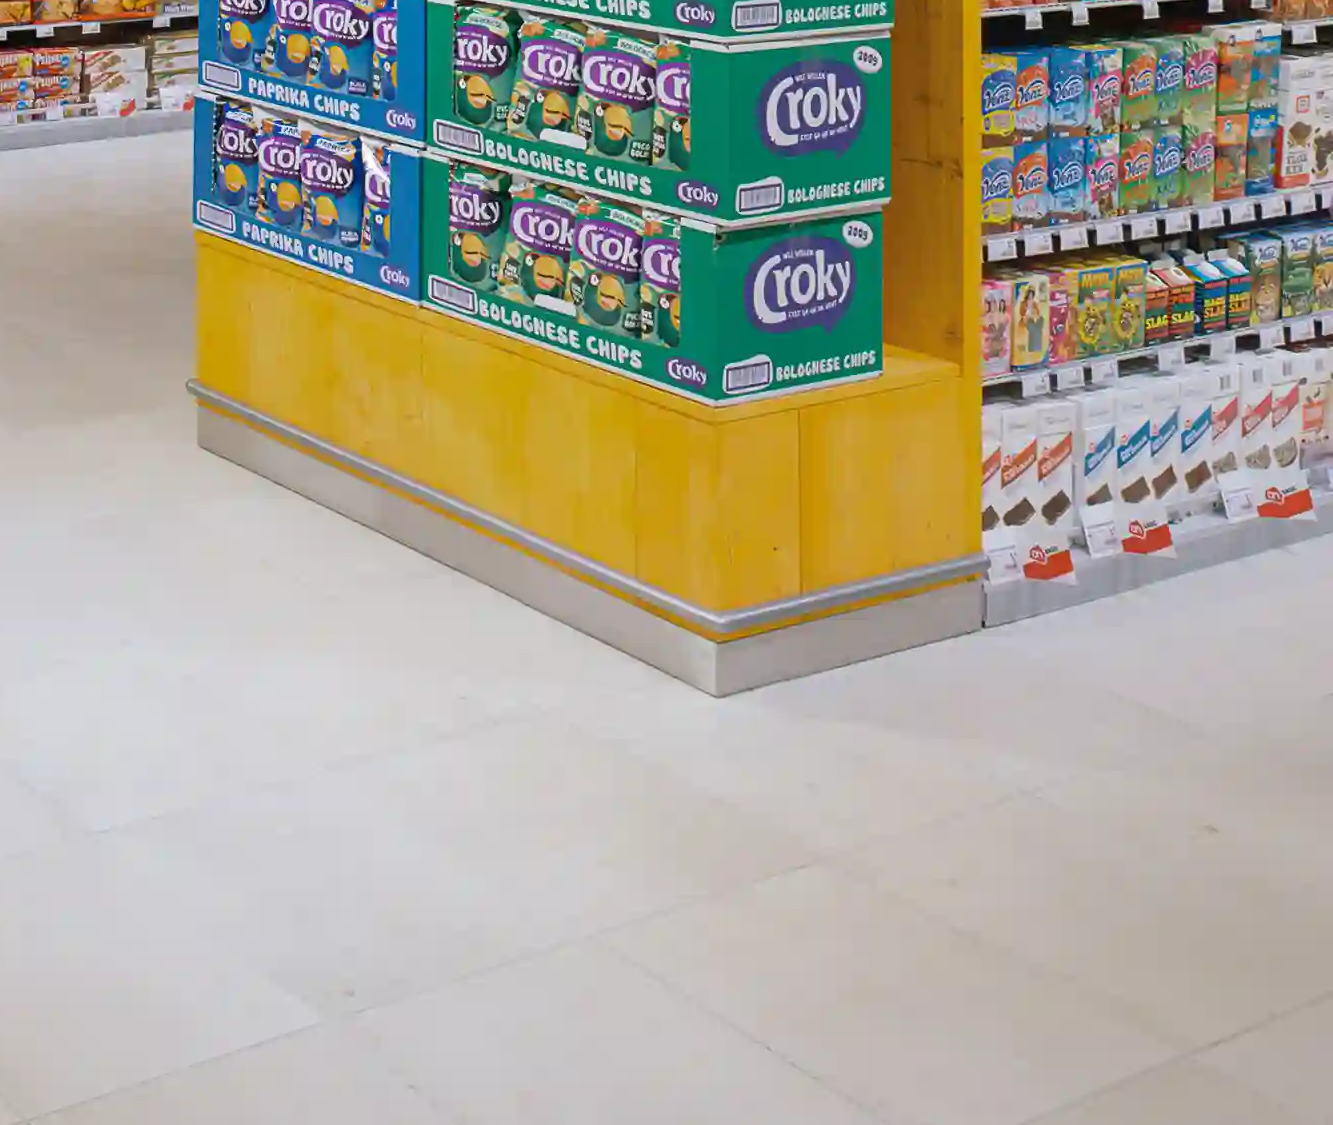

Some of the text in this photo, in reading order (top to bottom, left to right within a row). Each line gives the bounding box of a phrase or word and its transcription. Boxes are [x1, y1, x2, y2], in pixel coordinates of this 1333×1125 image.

[314, 2, 370, 40] Croky
[675, 2, 715, 24] Croky
[785, 1, 887, 24] BOLOGNESE CHIPS
[457, 33, 509, 69] roky
[523, 43, 582, 85] Crok
[248, 77, 361, 121] PAPRIKA CHIPS
[766, 73, 861, 146] Croky
[385, 109, 416, 130] Croky
[485, 139, 652, 197] BOLOGNESE CHIPS
[449, 193, 500, 223] roky
[677, 181, 719, 205] Croky
[787, 176, 886, 204] BOLOGNESE CHIPS
[512, 206, 573, 245] Crok
[242, 221, 354, 274] PAPRIKA CHIPS
[579, 224, 640, 267] Crok
[379, 265, 410, 287] Croky
[753, 249, 851, 324] Croky
[478, 298, 642, 369] BOLOGNESE CHIPS
[667, 358, 707, 385] Croky
[776, 349, 876, 382] BOLOGNESE CHIPS
